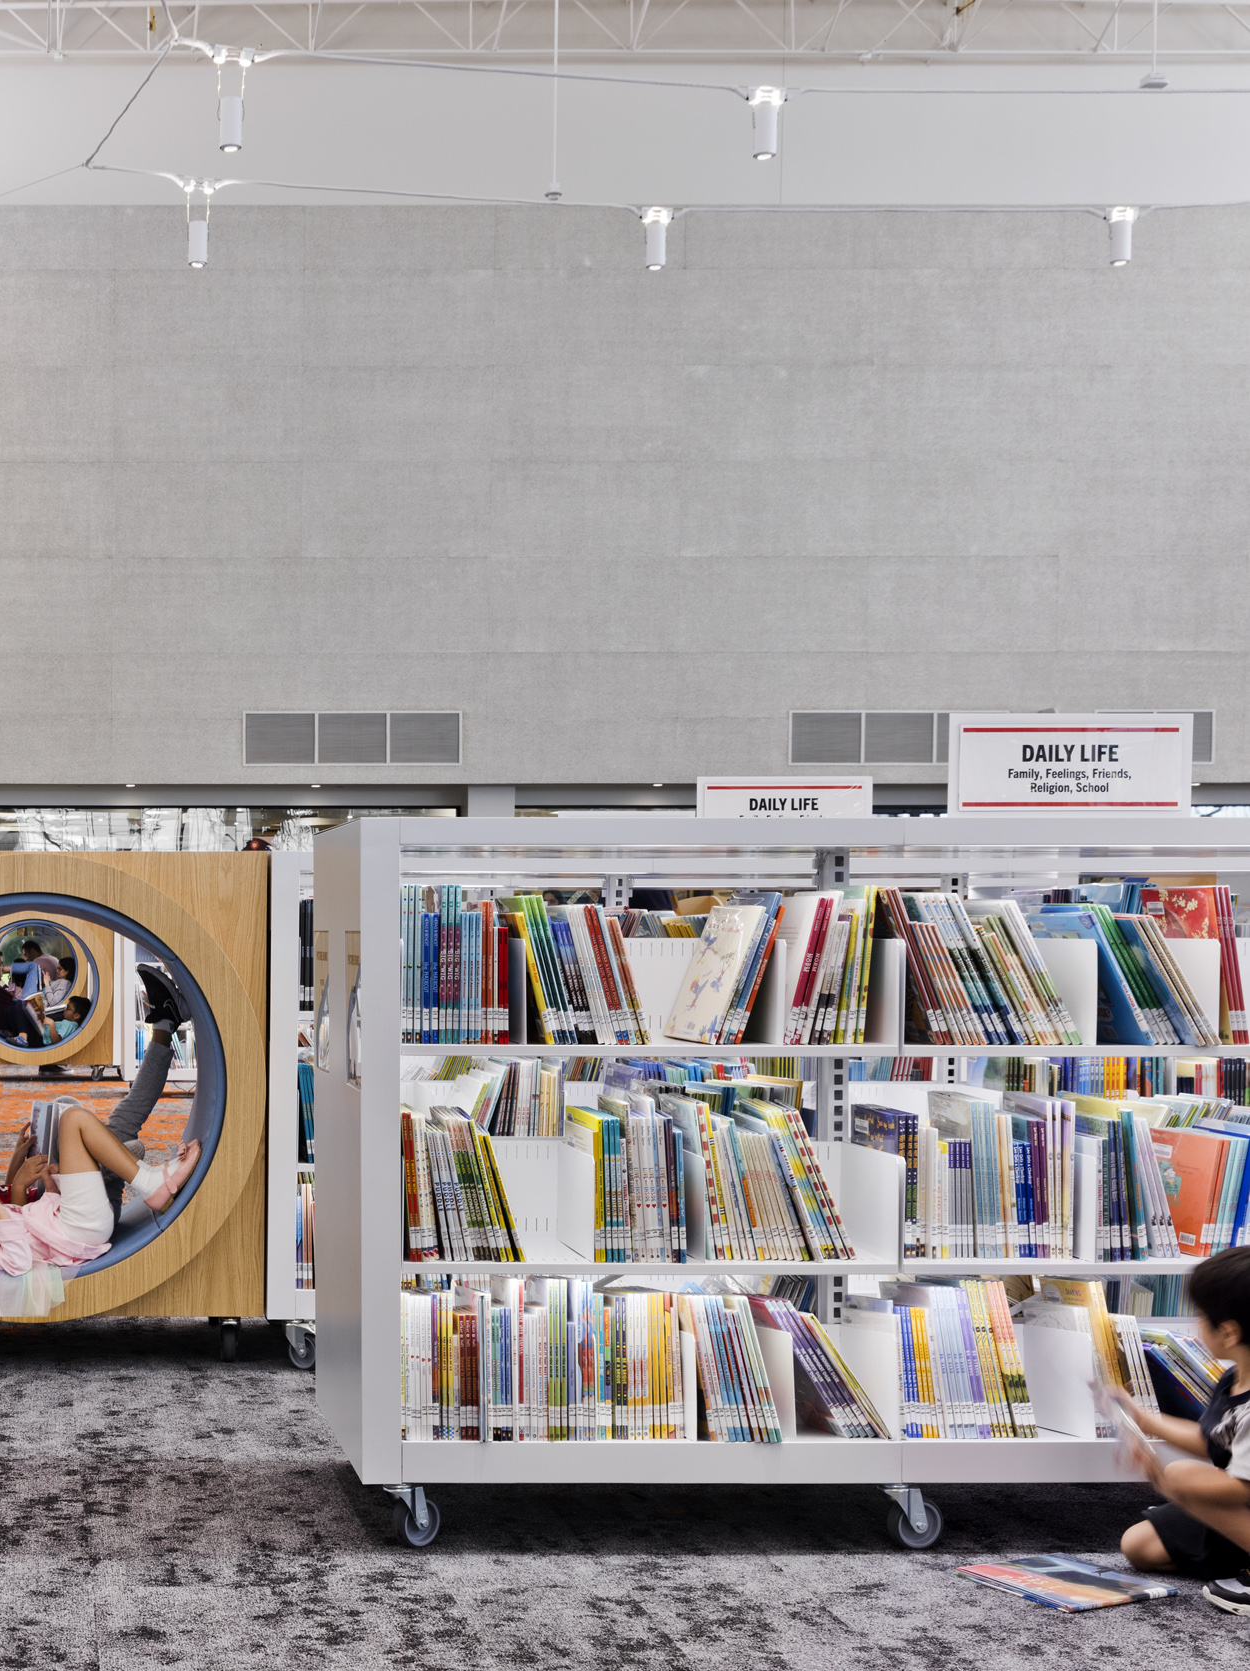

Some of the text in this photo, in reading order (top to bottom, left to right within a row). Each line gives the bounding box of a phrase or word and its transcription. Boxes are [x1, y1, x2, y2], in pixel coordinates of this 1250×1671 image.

[1022, 744, 1119, 762] DAILY LIFE
[1008, 768, 1132, 780] Family, Feelings, Friends,
[1030, 782, 1109, 795] Religion, School
[750, 798, 819, 811] DAILY LIFE
[811, 953, 820, 972] NORM
[477, 1154, 494, 1208] TROPICAL TERRY
[442, 1182, 452, 1212] PUDDLE
[446, 1182, 456, 1212] PUDDLE
[454, 1182, 464, 1212] PUDDLE
[479, 1190, 490, 1223] PROMISE
